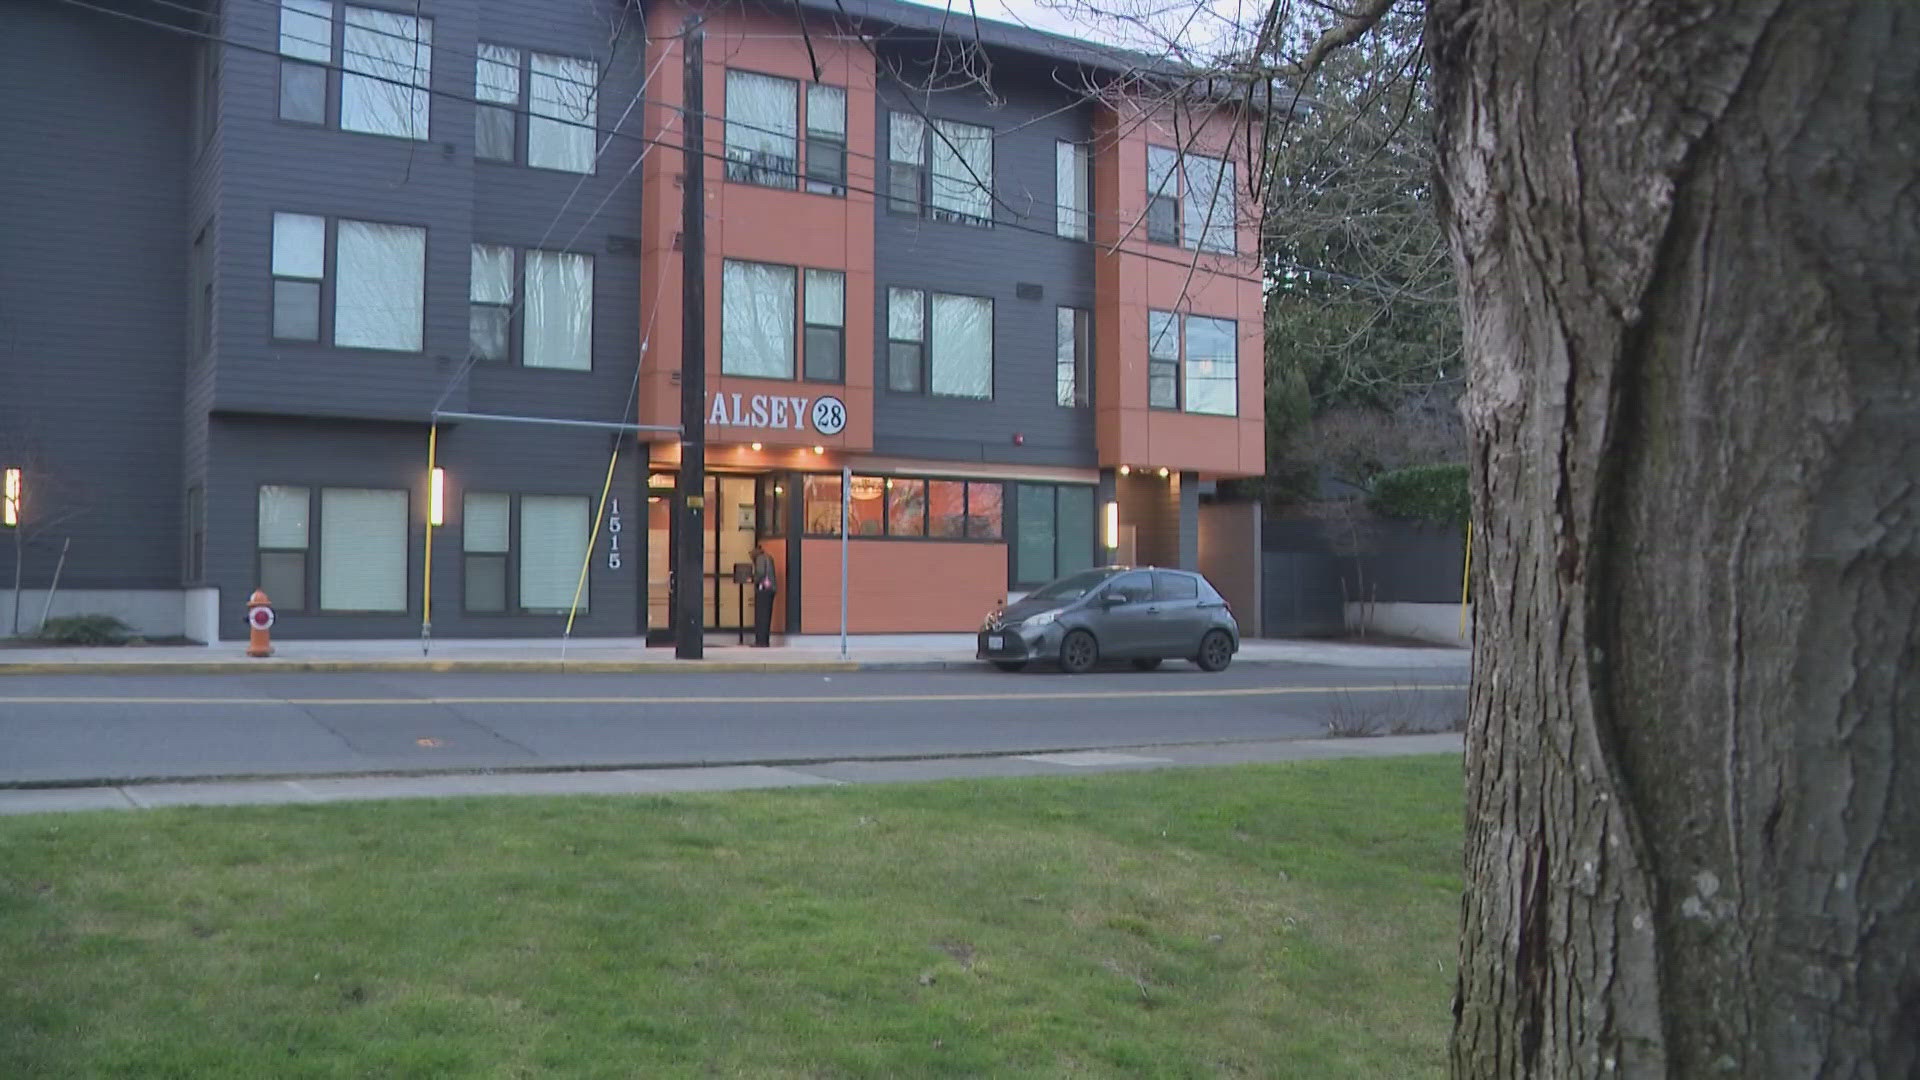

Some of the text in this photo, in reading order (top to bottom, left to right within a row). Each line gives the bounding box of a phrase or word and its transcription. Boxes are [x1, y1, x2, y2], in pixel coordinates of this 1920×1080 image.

[704, 391, 841, 430] ALSEY 28
[608, 498, 621, 569] 1515
